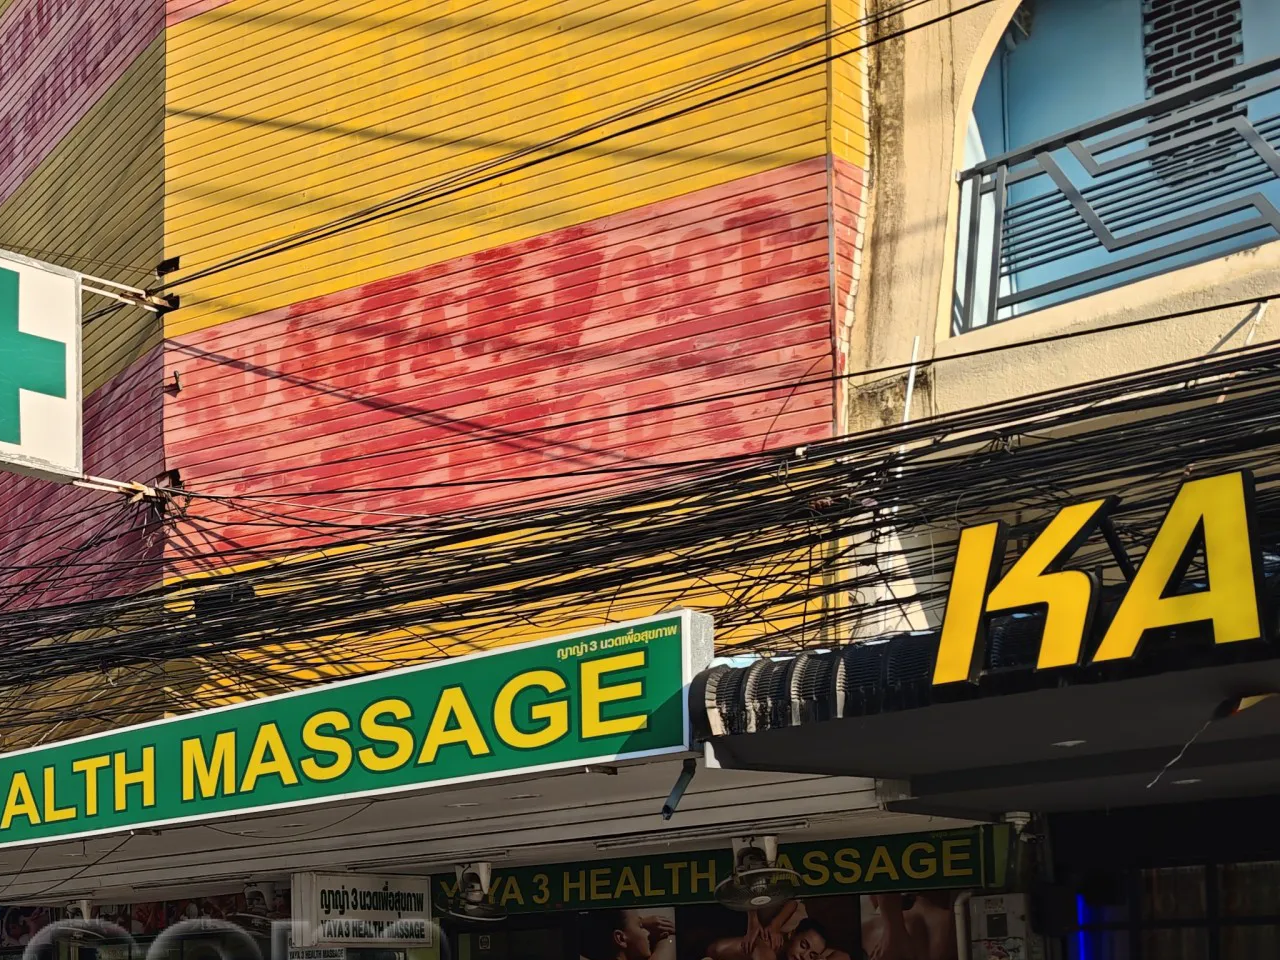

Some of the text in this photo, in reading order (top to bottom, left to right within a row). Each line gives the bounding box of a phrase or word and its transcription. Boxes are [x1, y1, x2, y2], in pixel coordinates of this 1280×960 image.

[932, 471, 1261, 685] KA
[589, 640, 598, 652] 3
[181, 649, 649, 801] MASSAGE
[351, 887, 358, 911] 3
[359, 880, 424, 918] นวดเพื่อสุขภาพ
[439, 838, 973, 907] YYA 3 HEALTH ASSAGE
[321, 919, 425, 939] YAYA 3 HEALTH MASSAGE
